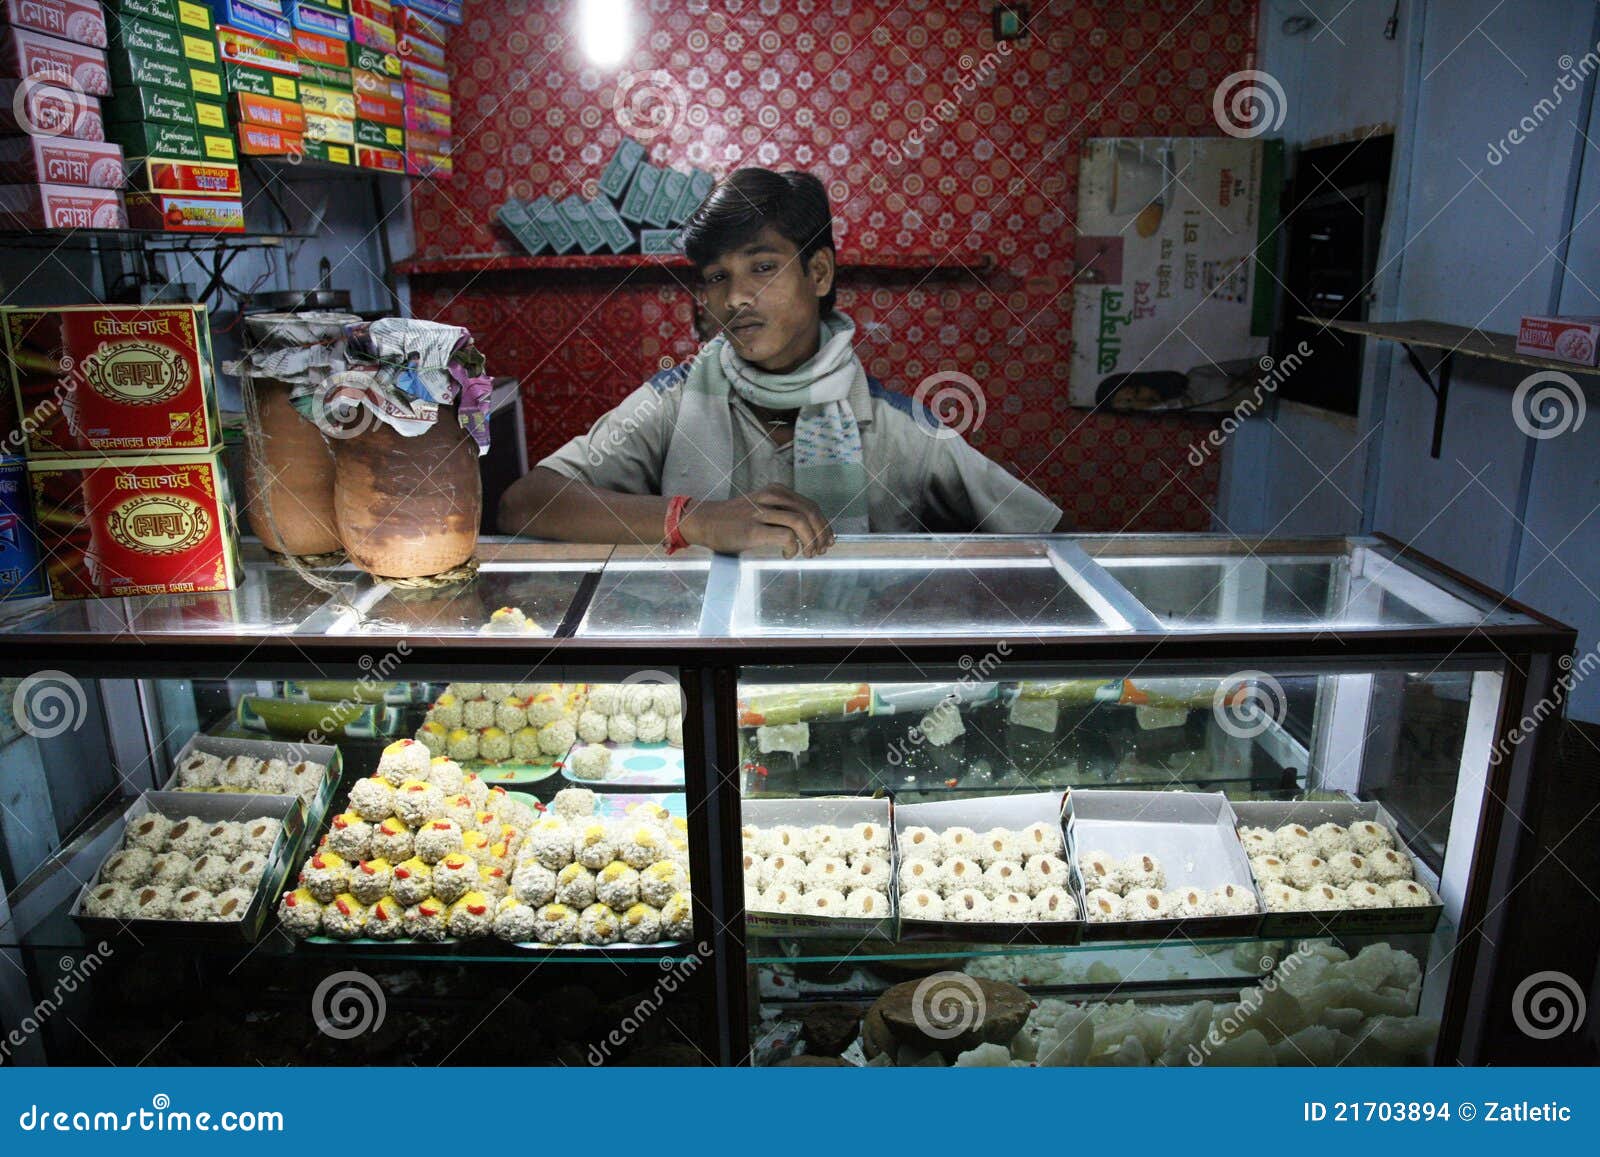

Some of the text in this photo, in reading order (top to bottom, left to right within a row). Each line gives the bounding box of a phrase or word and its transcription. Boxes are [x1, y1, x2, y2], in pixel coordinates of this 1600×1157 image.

[48, 159, 89, 182] মোয়া
[54, 207, 92, 228] মোয়া
[1097, 288, 1132, 374] আমূল
[111, 360, 166, 389] মোয়া
[132, 512, 187, 539] মোয়া
